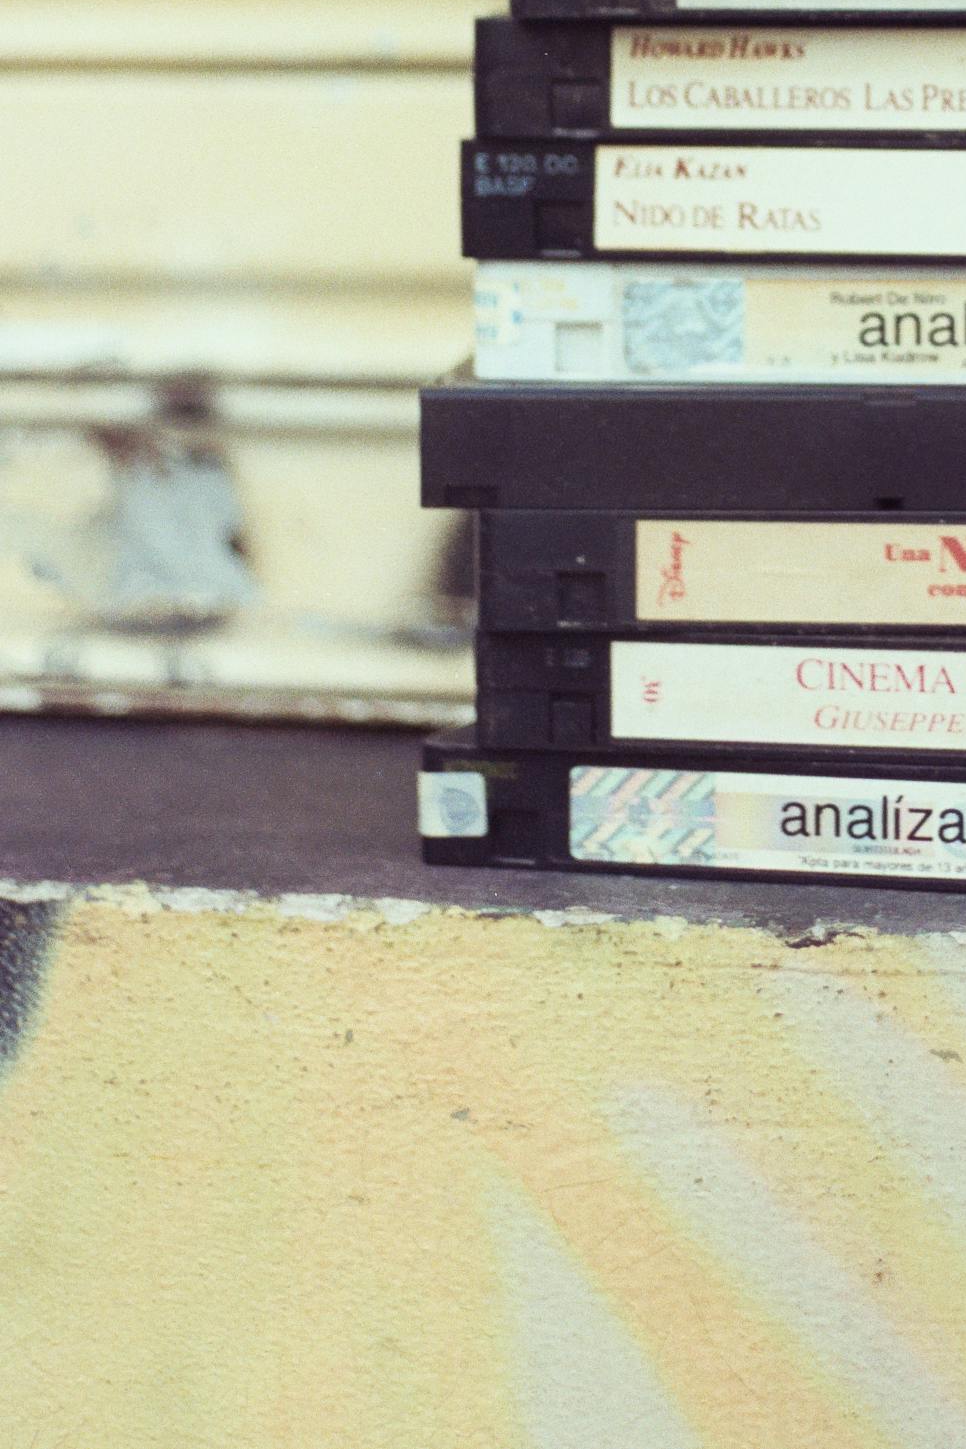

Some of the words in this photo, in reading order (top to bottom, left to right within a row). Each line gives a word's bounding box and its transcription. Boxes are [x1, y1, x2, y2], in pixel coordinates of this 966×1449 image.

[629, 81, 677, 109] LOS
[683, 82, 851, 110] CABALLEROS
[863, 83, 914, 112] LAS
[614, 201, 686, 229] NIDO
[693, 204, 723, 229] DE
[737, 201, 822, 231] RATAS
[885, 544, 931, 562] Una
[796, 658, 957, 695] CINEMA
[813, 705, 964, 735] GIUSEPPE
